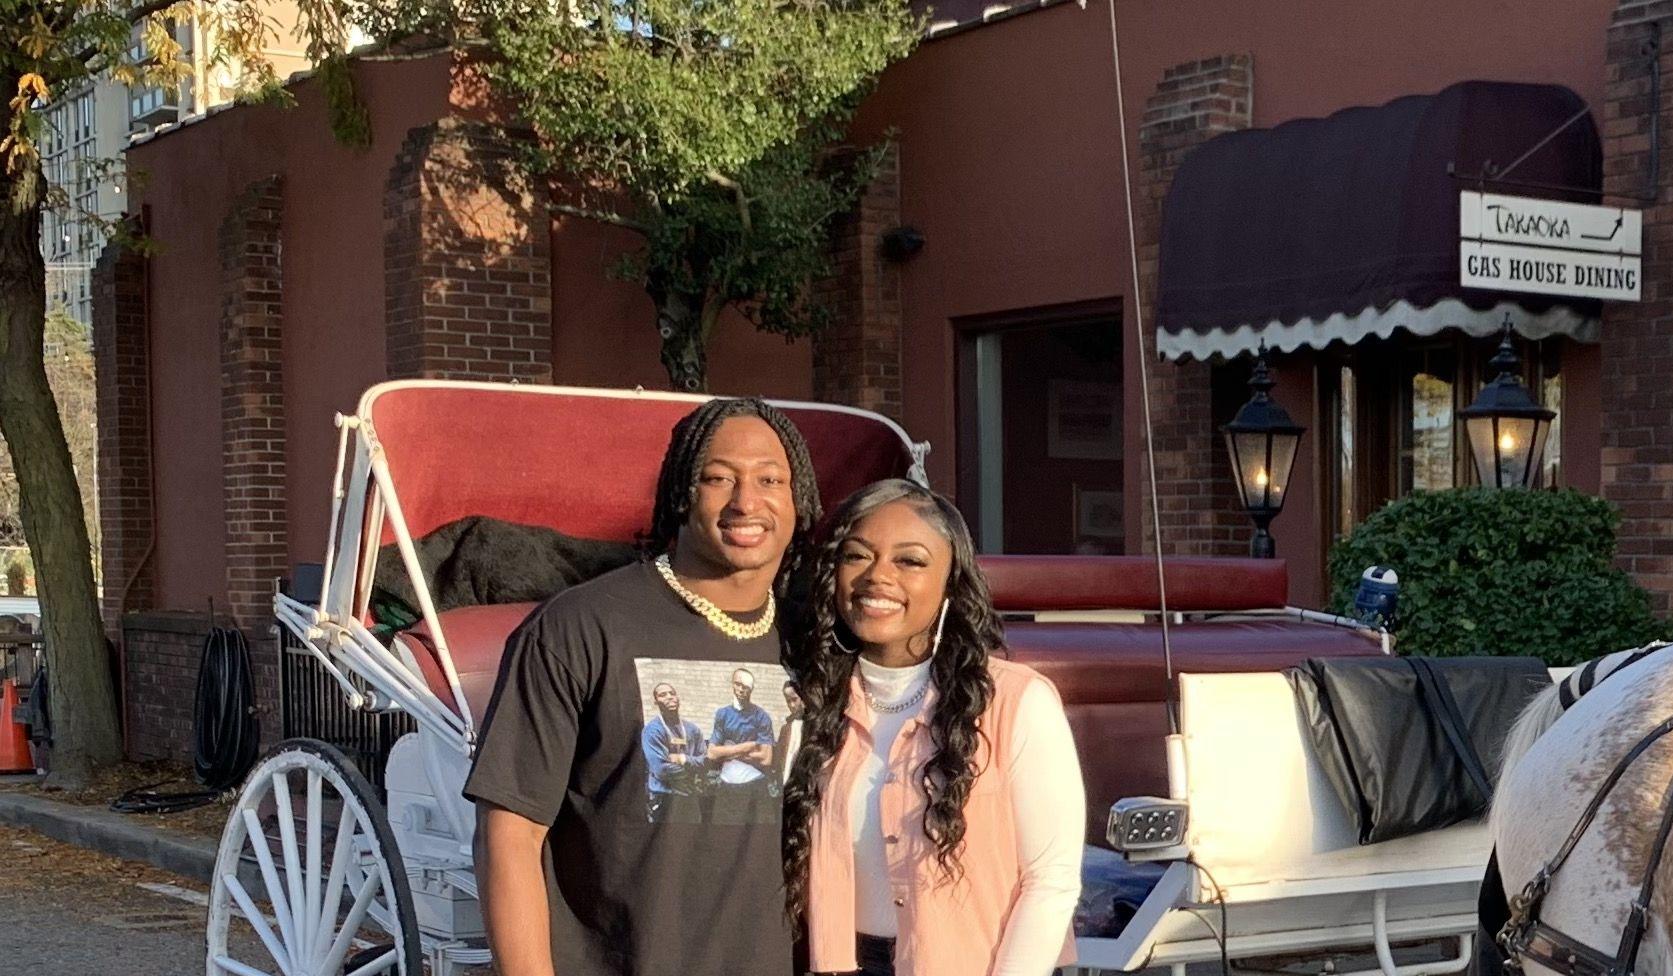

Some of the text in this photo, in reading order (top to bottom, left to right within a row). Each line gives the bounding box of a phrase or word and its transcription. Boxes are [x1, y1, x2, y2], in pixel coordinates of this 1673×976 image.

[1487, 205, 1570, 239] TAKAOKA
[1468, 255, 1636, 290] GAS HOUSE DINING
